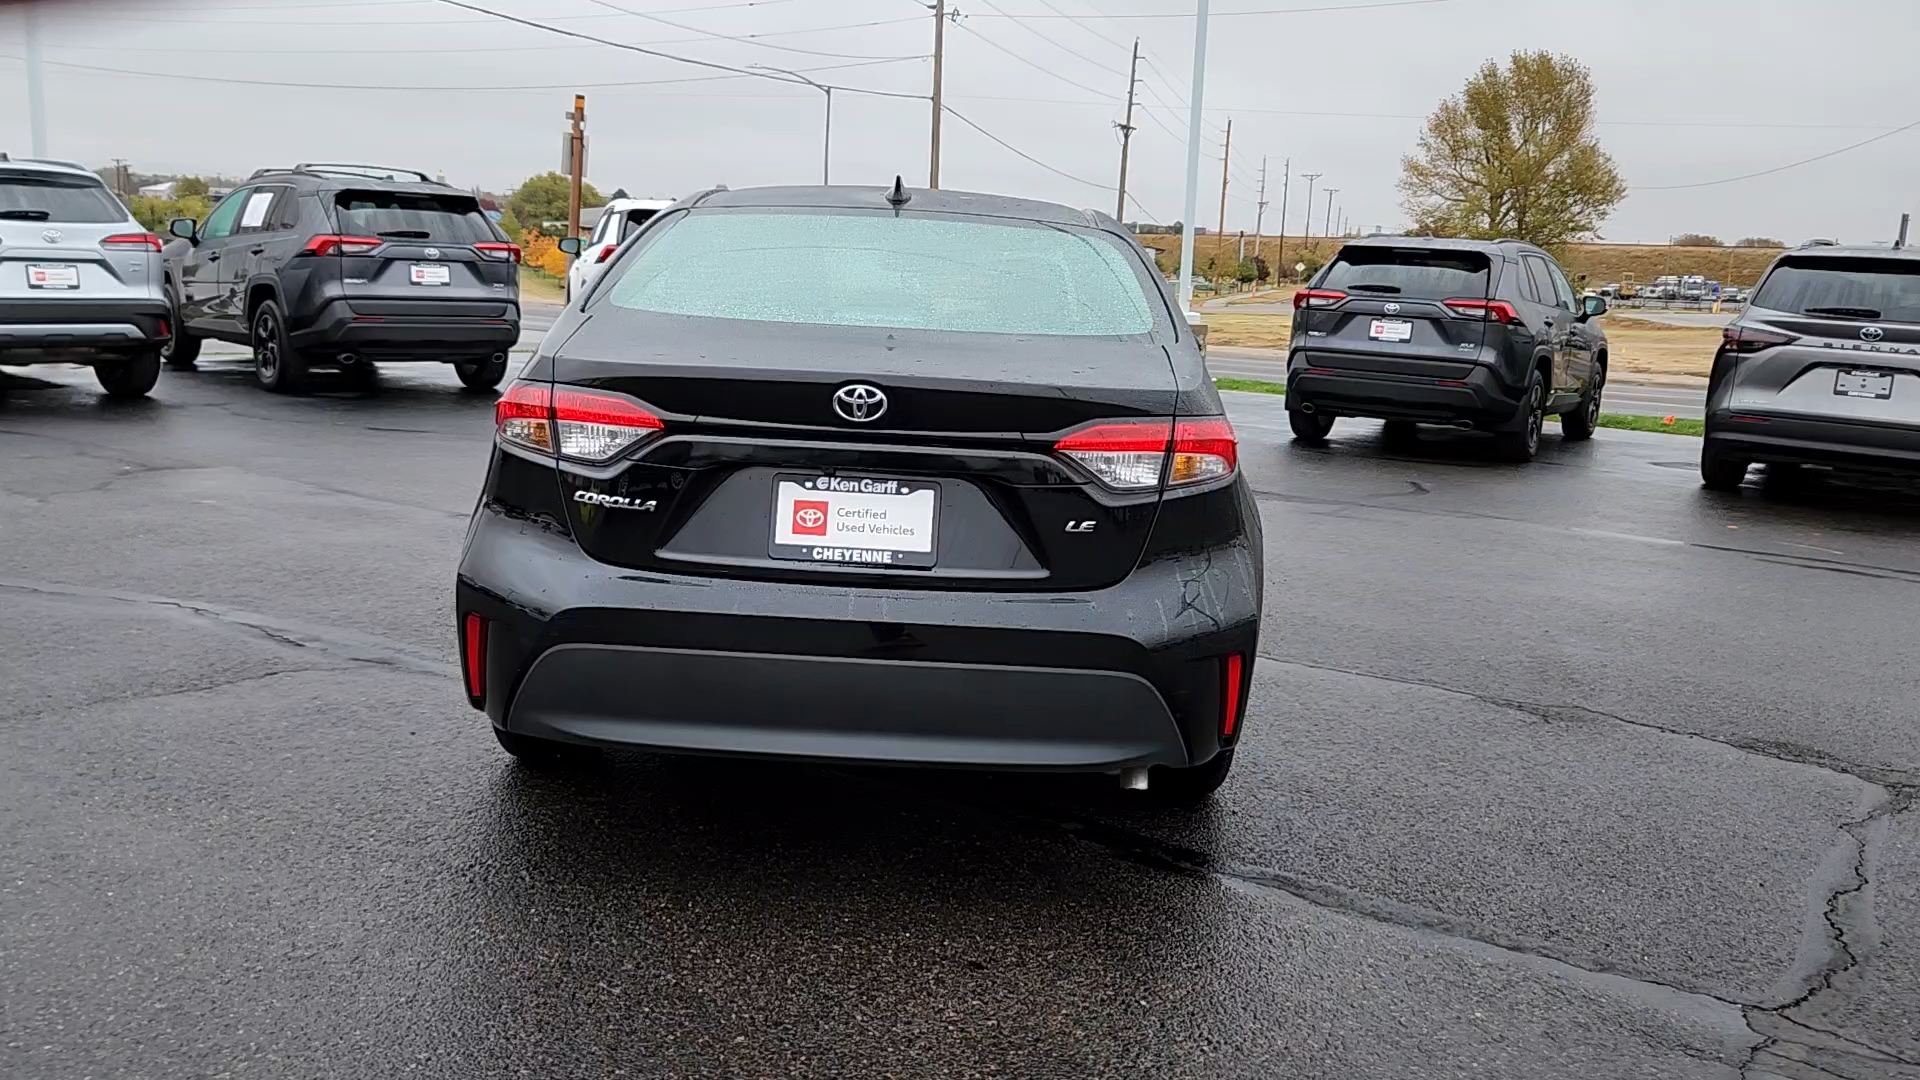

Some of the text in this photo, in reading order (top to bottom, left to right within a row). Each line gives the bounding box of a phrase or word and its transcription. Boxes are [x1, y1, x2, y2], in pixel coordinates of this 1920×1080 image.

[829, 477, 859, 492] Ken
[860, 479, 898, 494] Garff
[573, 490, 658, 512] COROLLA
[836, 507, 887, 520] Certified
[836, 521, 915, 536] Used Vehicles
[1064, 520, 1097, 532] LE
[812, 547, 893, 563] CHEYENNE
